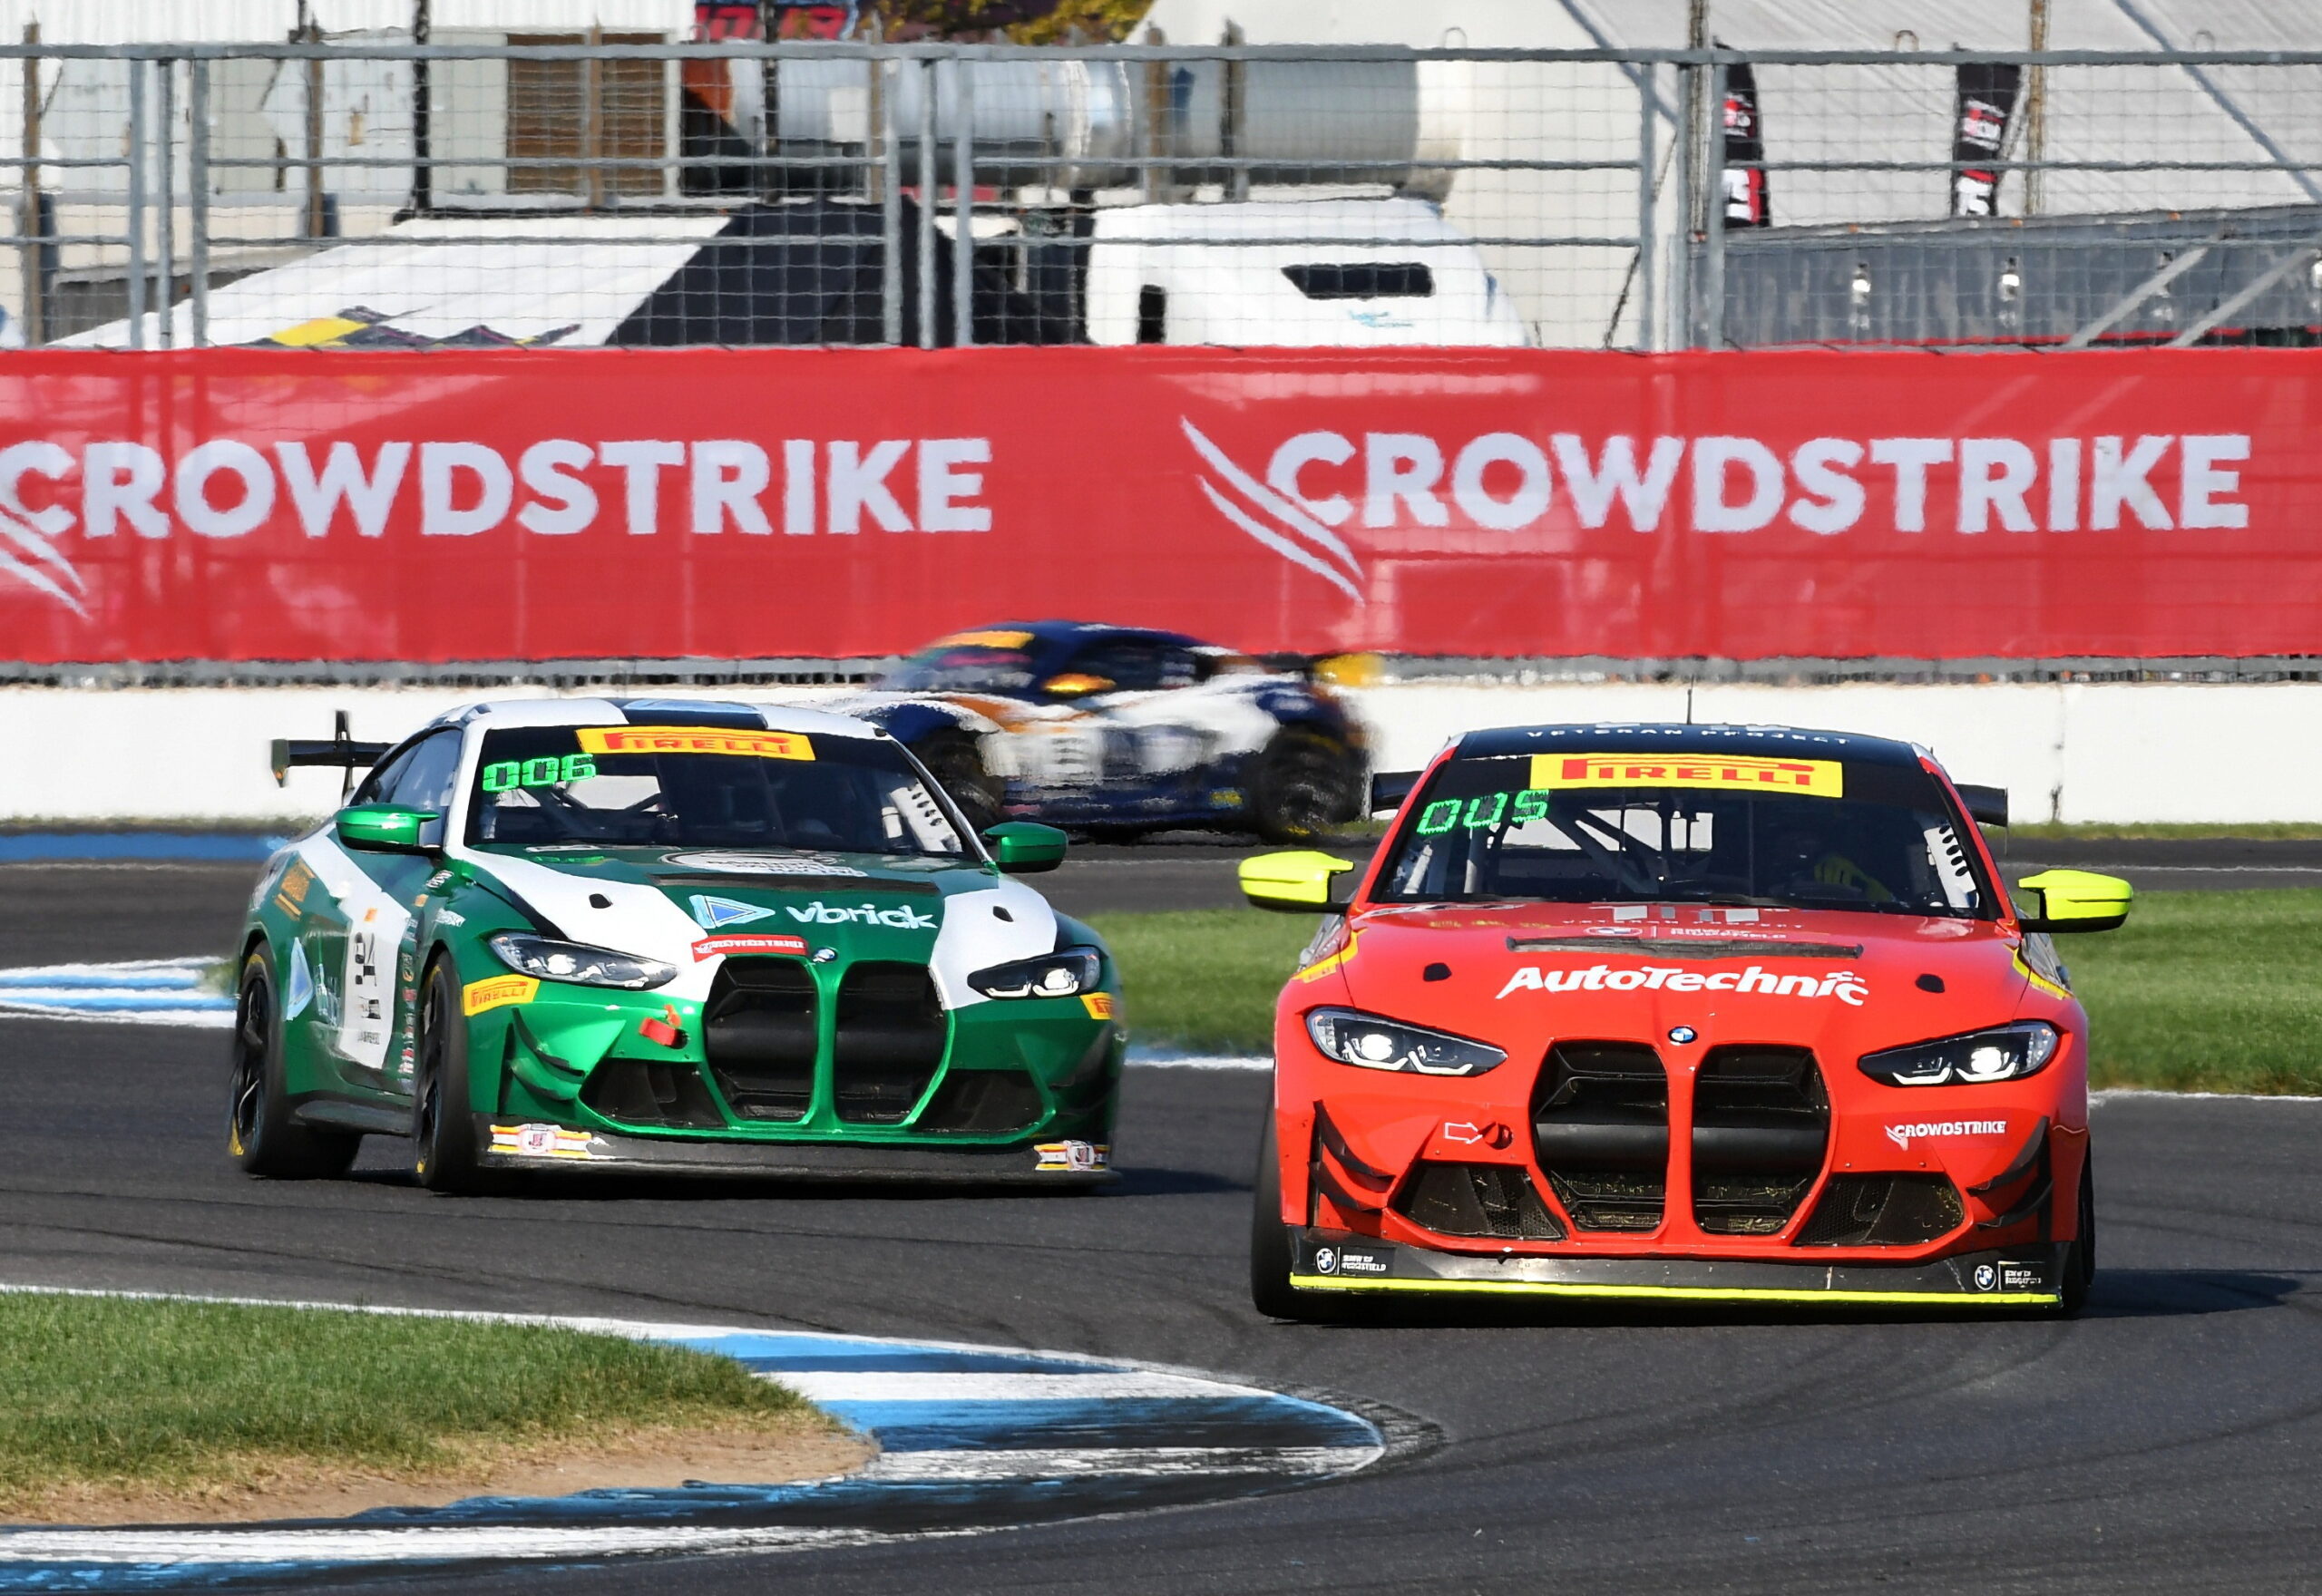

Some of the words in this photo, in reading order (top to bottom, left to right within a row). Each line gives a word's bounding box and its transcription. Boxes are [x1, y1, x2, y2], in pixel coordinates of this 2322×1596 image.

[0, 438, 993, 539] CROWDSTRIKE
[1266, 431, 2250, 534] CROWDSTRIKE
[603, 732, 792, 754] PIRELLI
[483, 753, 598, 793] 006
[1562, 755, 1815, 786] PIRELLI
[785, 900, 939, 929] vbrick
[471, 980, 529, 1007] PIRELLI
[1495, 964, 1869, 1007] AutoTechnic
[1893, 1120, 2007, 1139] CROWDSTRIKE
